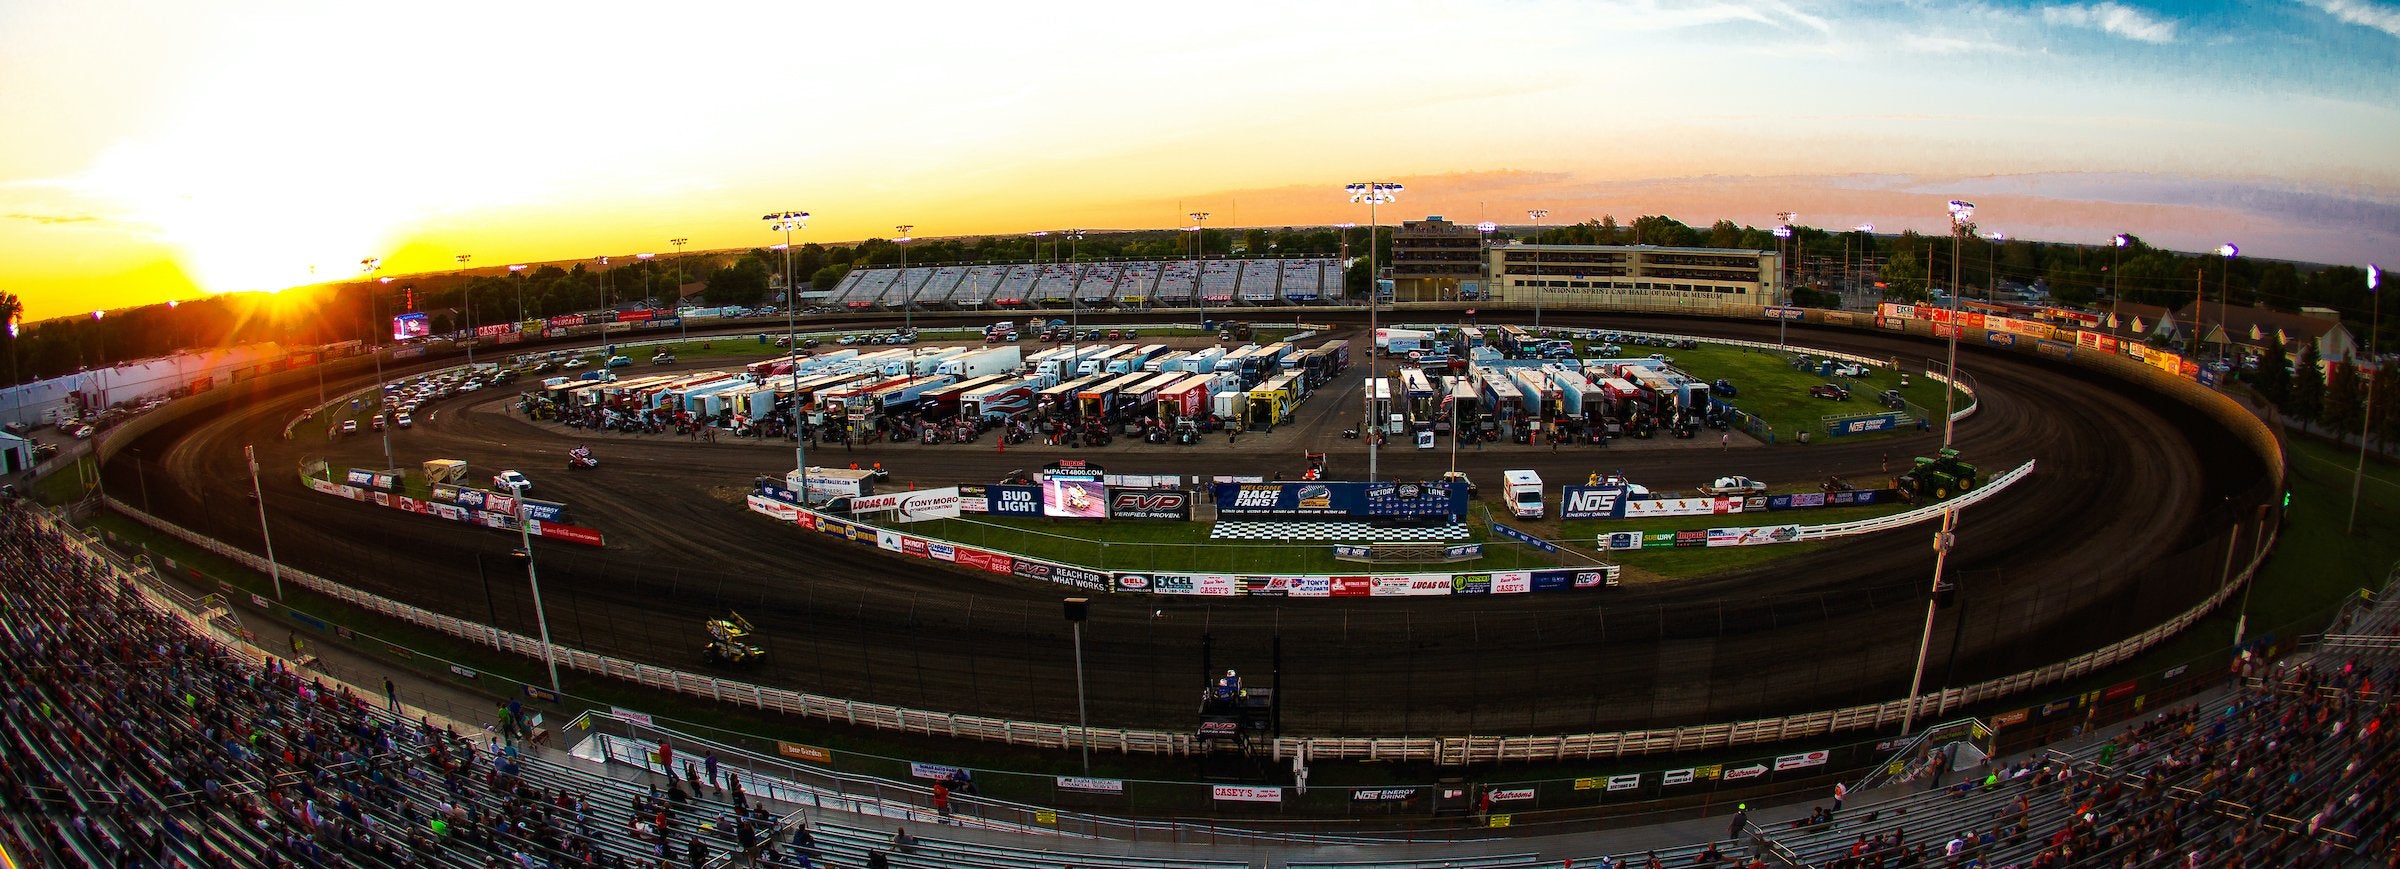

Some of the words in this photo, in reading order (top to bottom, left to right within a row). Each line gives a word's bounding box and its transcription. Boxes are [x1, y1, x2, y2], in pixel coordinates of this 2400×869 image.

[1933, 309, 1949, 322] 3M
[558, 318, 575, 327] LUCAS
[576, 316, 585, 325] OIL
[478, 323, 510, 337] CASEY'S
[1141, 389, 1158, 405] KILLER
[1848, 421, 1866, 432] NOS
[1060, 459, 1085, 467] Impact
[1043, 468, 1103, 476] IMPACT4800.COM
[1002, 491, 1031, 501] BUD
[1238, 490, 1280, 499] RACE
[1370, 487, 1395, 497] VICTORY
[1428, 488, 1446, 497] LANE
[853, 499, 881, 510] LUCAS
[882, 497, 897, 506] OIL
[909, 500, 932, 508] TONY
[932, 496, 959, 506] MORO
[1111, 492, 1185, 511] FVP
[1234, 498, 1279, 506] FANS!
[1568, 487, 1622, 512] NOS
[535, 506, 559, 515] ENERGY
[997, 501, 1037, 512] LIGHT
[1643, 533, 1674, 541] SUBWAY
[1677, 530, 1706, 540] Impact
[991, 563, 1012, 574] BEERS
[1013, 561, 1049, 575] FVP
[1056, 568, 1082, 579] REACH
[1084, 571, 1100, 582] FOR
[1052, 575, 1075, 586] WHAT
[1155, 576, 1193, 588] EXCEL
[1412, 581, 1437, 589] LUCAS
[1496, 584, 1524, 592] CASEY'S
[1201, 721, 1237, 730] FVP
[789, 745, 800, 753] Beer
[800, 748, 822, 757] Garden
[1726, 768, 1760, 778] Restrooms
[1215, 788, 1253, 798] CASEY'S
[1354, 790, 1382, 800] NOS
[1492, 790, 1533, 800] Restrooms
